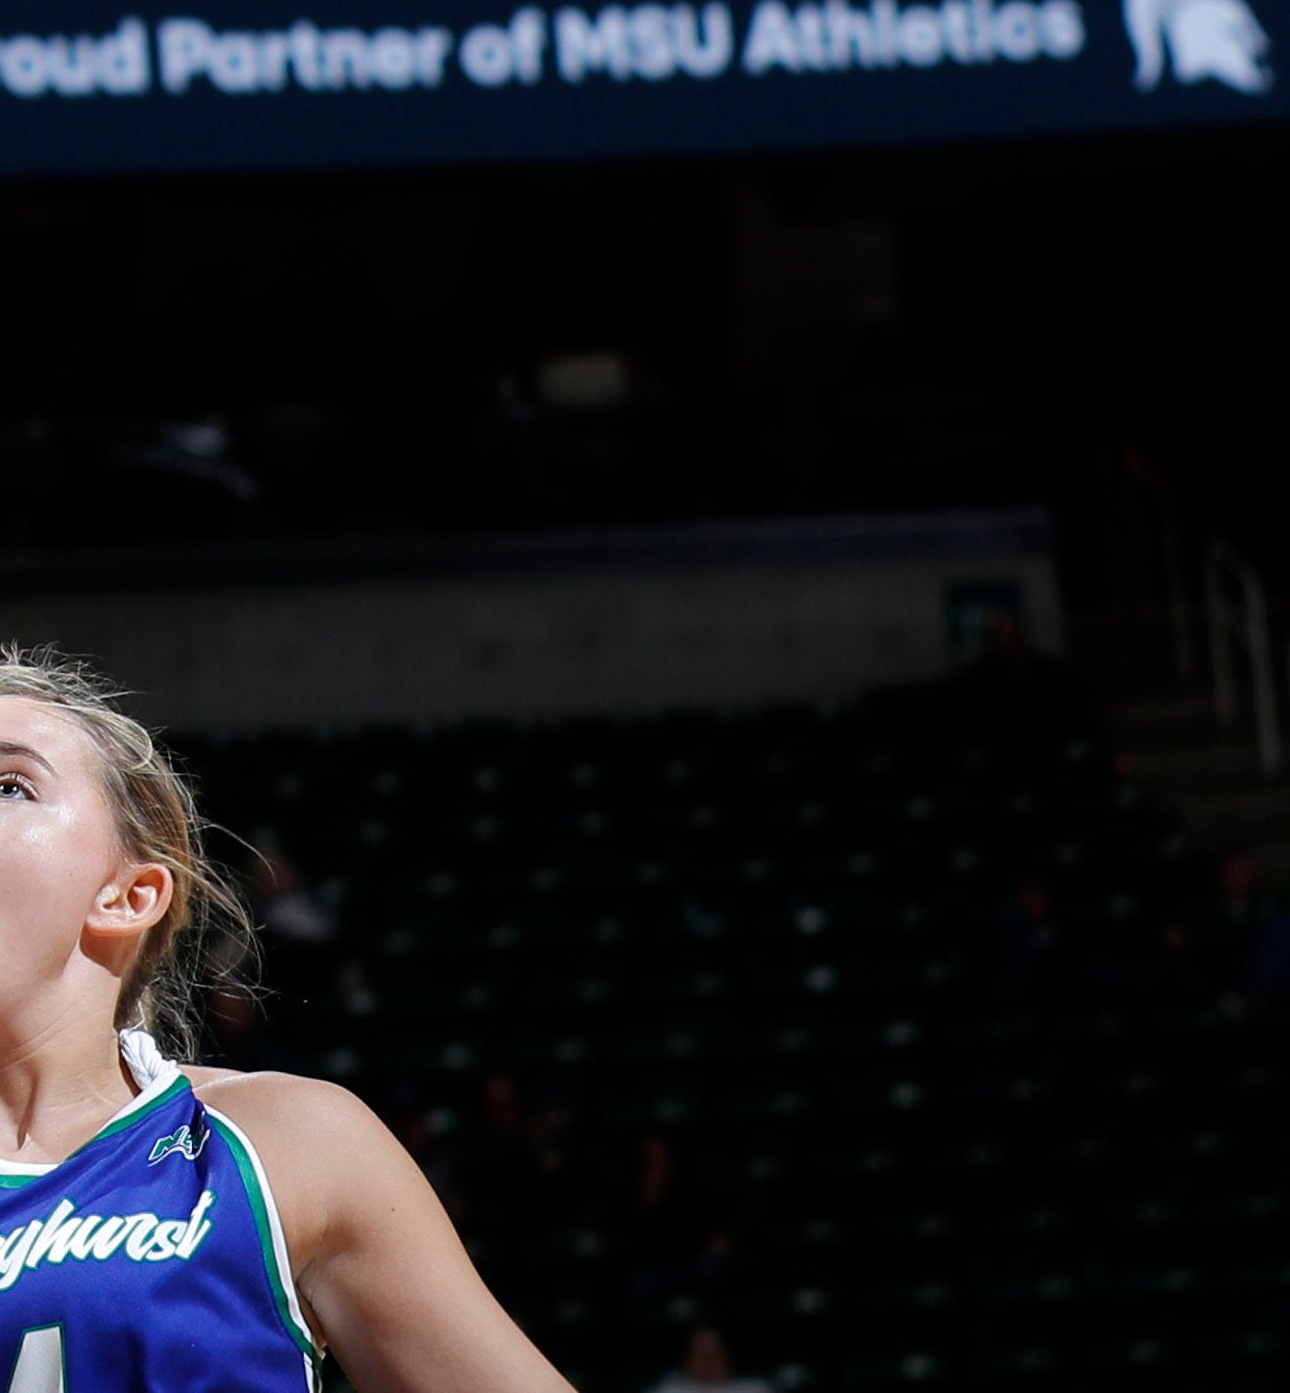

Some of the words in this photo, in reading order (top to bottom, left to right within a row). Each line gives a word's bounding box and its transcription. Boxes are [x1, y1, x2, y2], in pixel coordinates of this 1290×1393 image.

[157, 18, 451, 92] Partner
[459, 8, 546, 86] of
[554, 3, 734, 80] MSU
